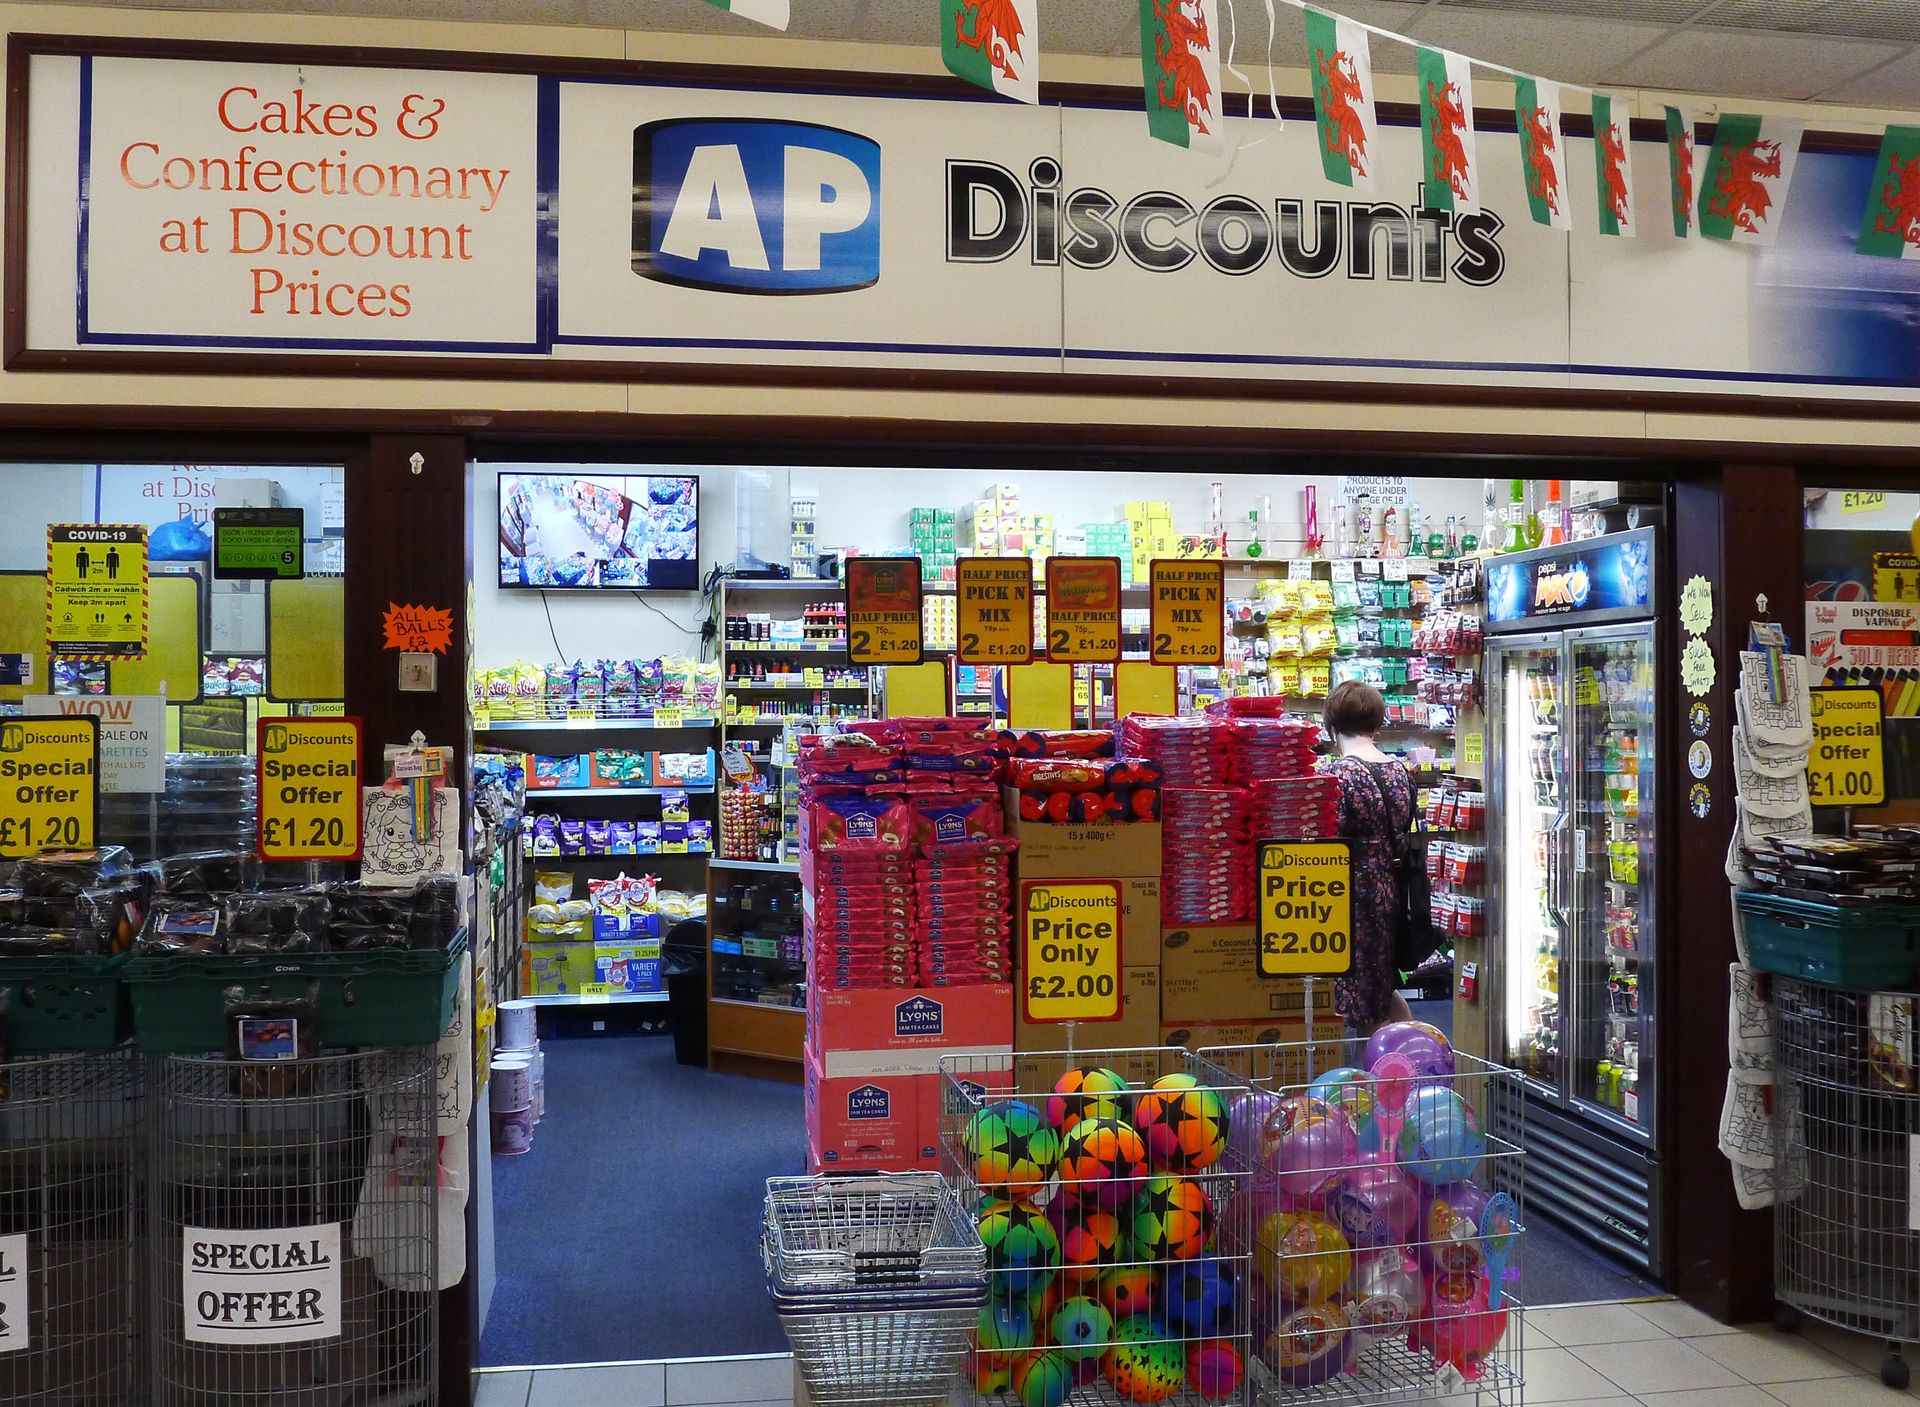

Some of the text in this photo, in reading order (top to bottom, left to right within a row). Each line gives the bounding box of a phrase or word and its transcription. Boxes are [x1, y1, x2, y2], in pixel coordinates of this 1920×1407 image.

[217, 86, 445, 140] Cakes &
[119, 142, 511, 212] Confectionary
[660, 143, 1505, 287] AP Discounts
[160, 208, 472, 260] at Discount
[250, 268, 412, 318] Prices
[142, 482, 163, 498] at
[1344, 486, 1407, 494] ANYONE UNDER
[1394, 496, 1404, 504] 18
[68, 530, 127, 540] COVID-19
[284, 552, 292, 562] 5
[963, 570, 1029, 580] HALF PRICE
[1156, 571, 1220, 580] HALF PRICE
[1538, 561, 1556, 576] pepsi
[966, 586, 1026, 600] PICK N
[1159, 587, 1216, 600] PICK N
[393, 612, 423, 622] ALL
[852, 612, 917, 622] HALF PRICE
[978, 608, 1010, 622] MIX
[1052, 612, 1117, 621] HALF PRICE
[1171, 610, 1202, 622] MIX
[1852, 608, 1912, 618] DISPOSABLE
[876, 626, 888, 635] 75p
[1074, 626, 1088, 634] 75p
[1865, 618, 1900, 626] VAPING
[852, 630, 918, 655] 2 £1.20
[962, 633, 1026, 656] 2 £1.20
[1051, 630, 1116, 654] 2 £1.20
[1155, 634, 1217, 655] 2 £1.20
[1850, 647, 1920, 666] SOLD HERE
[59, 700, 132, 720] WOW
[1825, 700, 1877, 710] Discounts
[2, 728, 90, 749] AP Discounts
[130, 730, 148, 741] ON
[265, 729, 354, 750] AP Discounts
[1820, 745, 1870, 760] Offer
[1, 758, 93, 780] Special
[264, 760, 356, 781] Special
[1032, 770, 1061, 781] DIGESTIVES
[1809, 770, 1872, 796] £1.00
[16, 786, 79, 804] Offer
[280, 786, 343, 804] Offer
[0, 816, 80, 846] £1.20
[264, 818, 344, 846] £1.20
[1068, 831, 1077, 840] 15
[1086, 831, 1104, 842] 400g
[1264, 850, 1350, 866] AP Discounts
[1266, 876, 1346, 897] Price
[1030, 892, 1117, 908] AP Discounts
[1274, 901, 1333, 924] Only
[1032, 918, 1112, 940] Price
[1218, 938, 1249, 947] Coconut
[1264, 932, 1346, 954] £2.00
[1041, 944, 1099, 966] Only
[632, 962, 658, 971] VARIETY
[1030, 974, 1114, 999] £2.00
[192, 1240, 330, 1270] SPECIAL
[197, 1288, 325, 1322] OFFER
